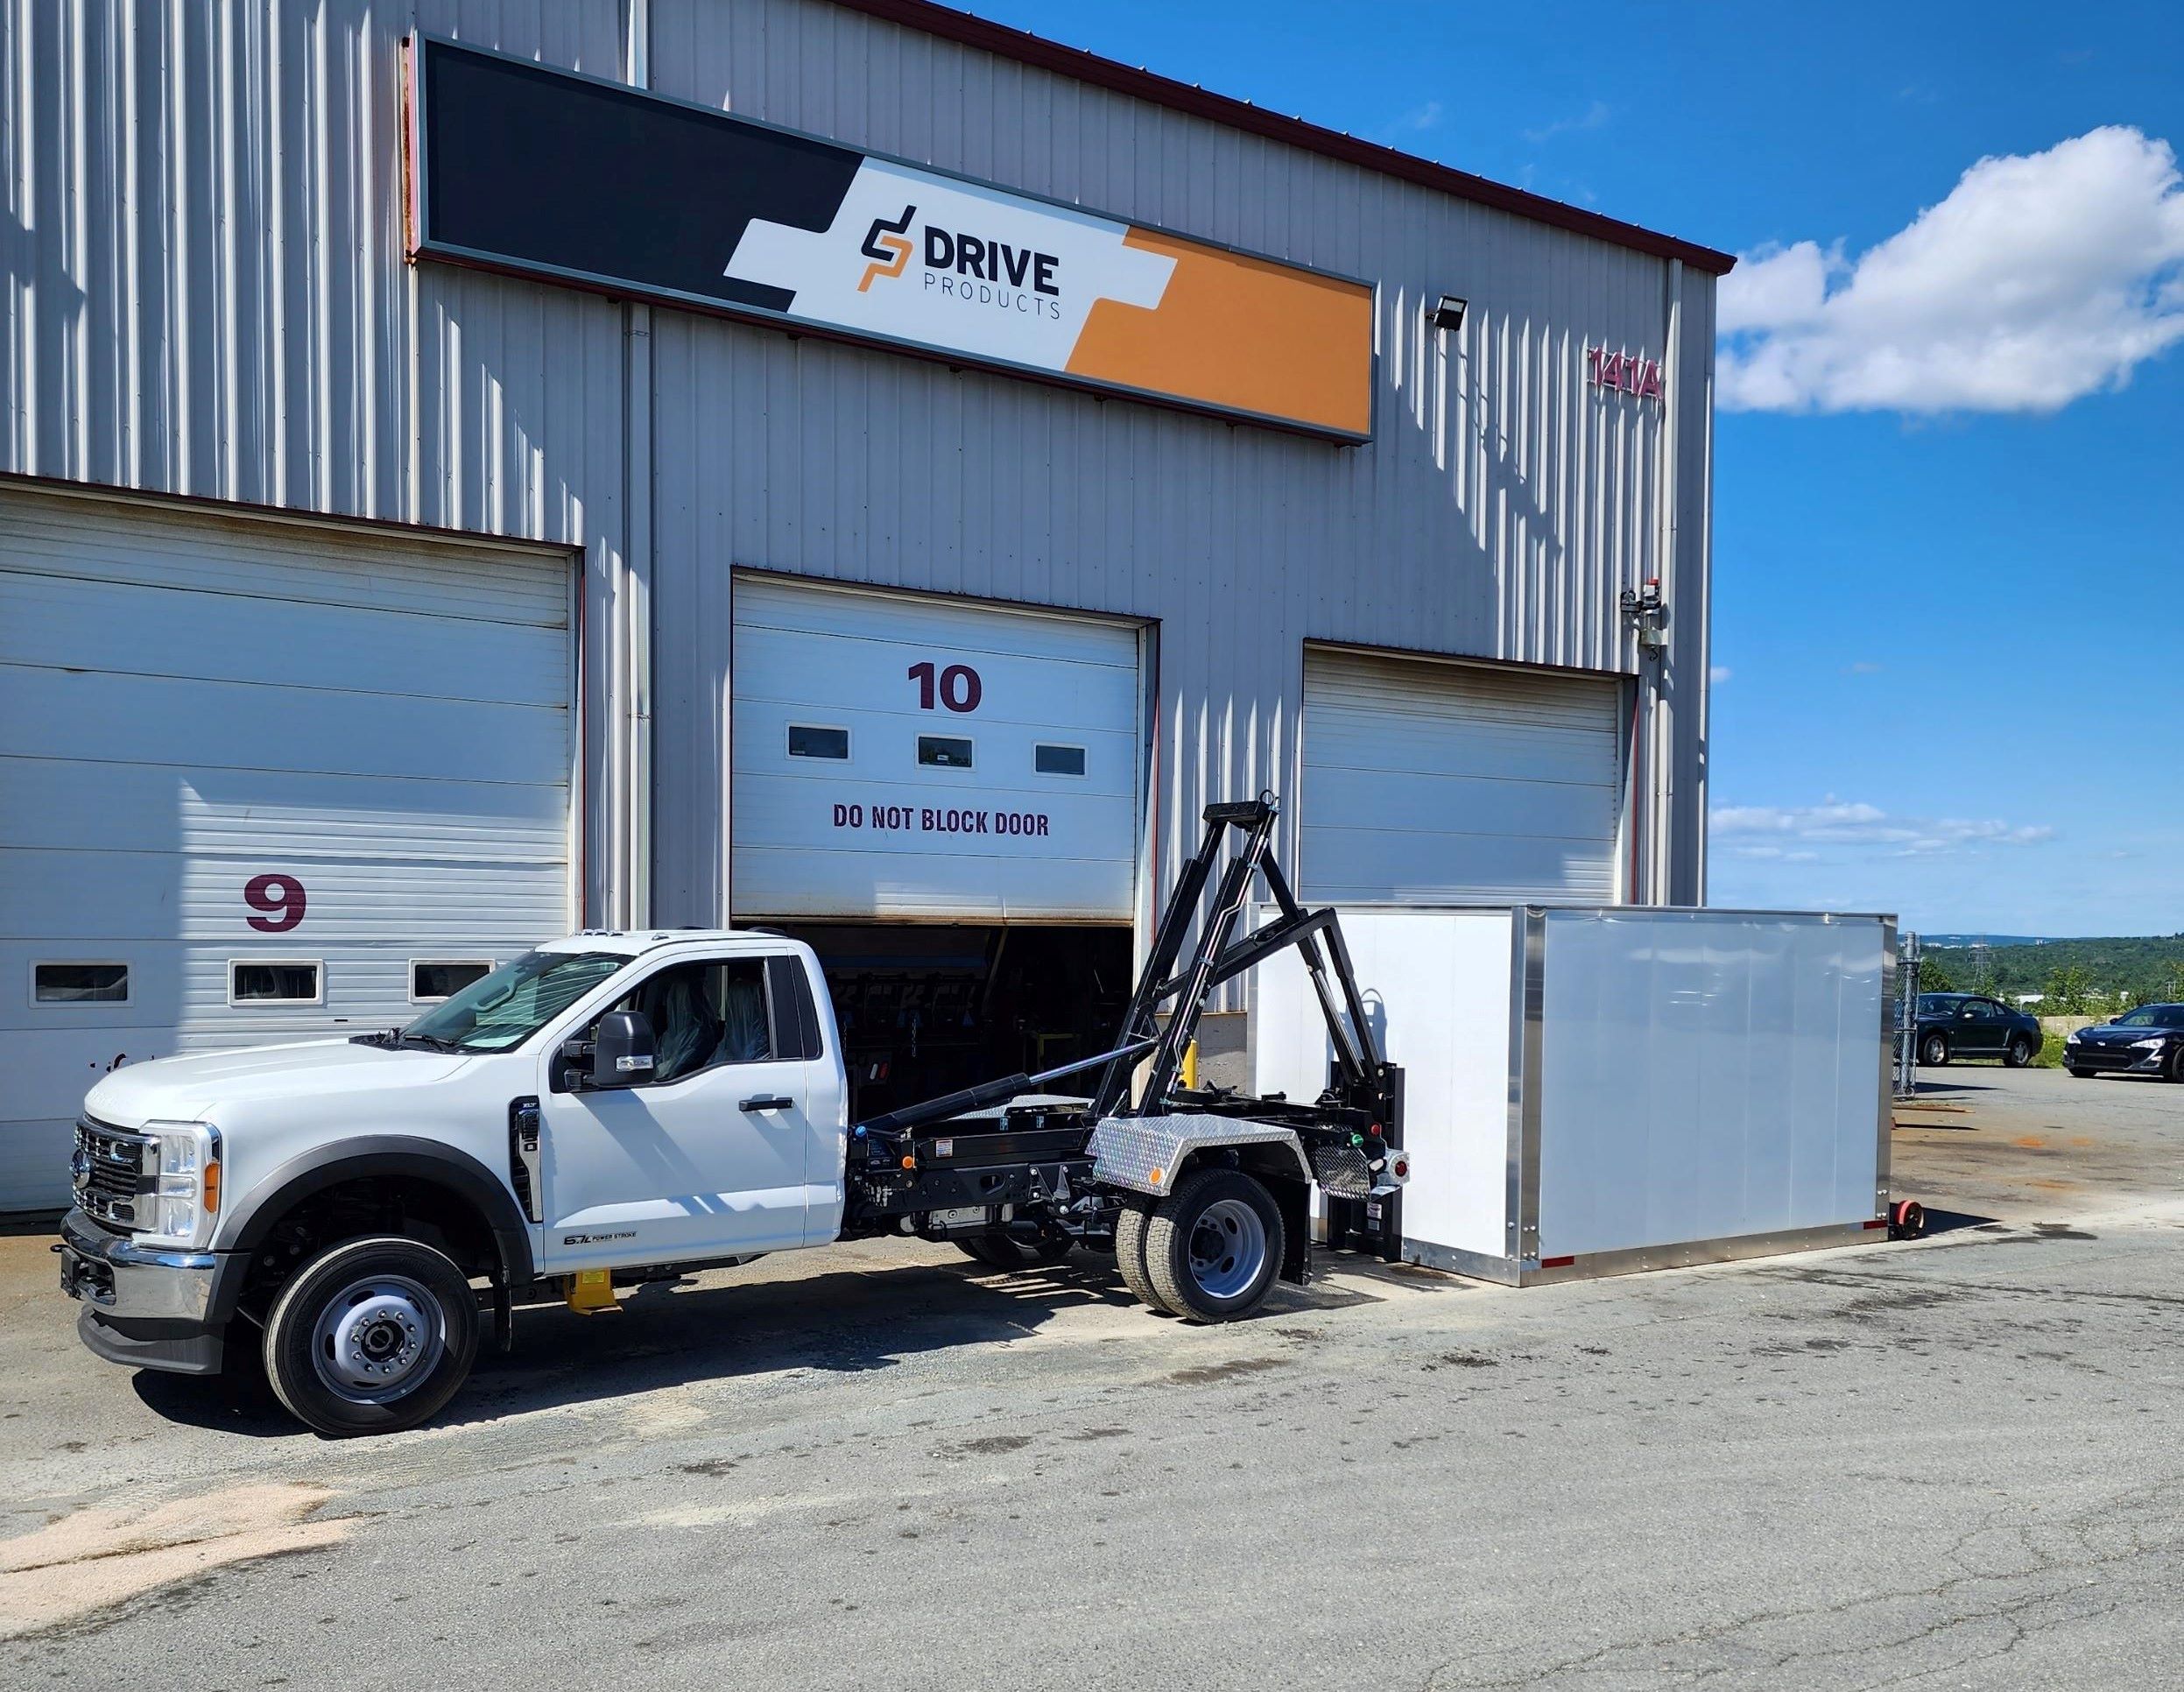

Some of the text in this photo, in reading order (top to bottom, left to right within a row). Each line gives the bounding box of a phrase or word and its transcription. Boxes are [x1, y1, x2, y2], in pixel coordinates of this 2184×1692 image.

[925, 225, 1060, 297] DRIVE
[925, 272, 1060, 320] PRODUCTS
[1588, 347, 1663, 401] 141A
[908, 662, 983, 713] 10
[834, 804, 1049, 836] DO NOT BLOCK DOOR
[244, 874, 306, 933] 9
[564, 1234, 591, 1245] 6.7L
[614, 1230, 638, 1239] STROKE
